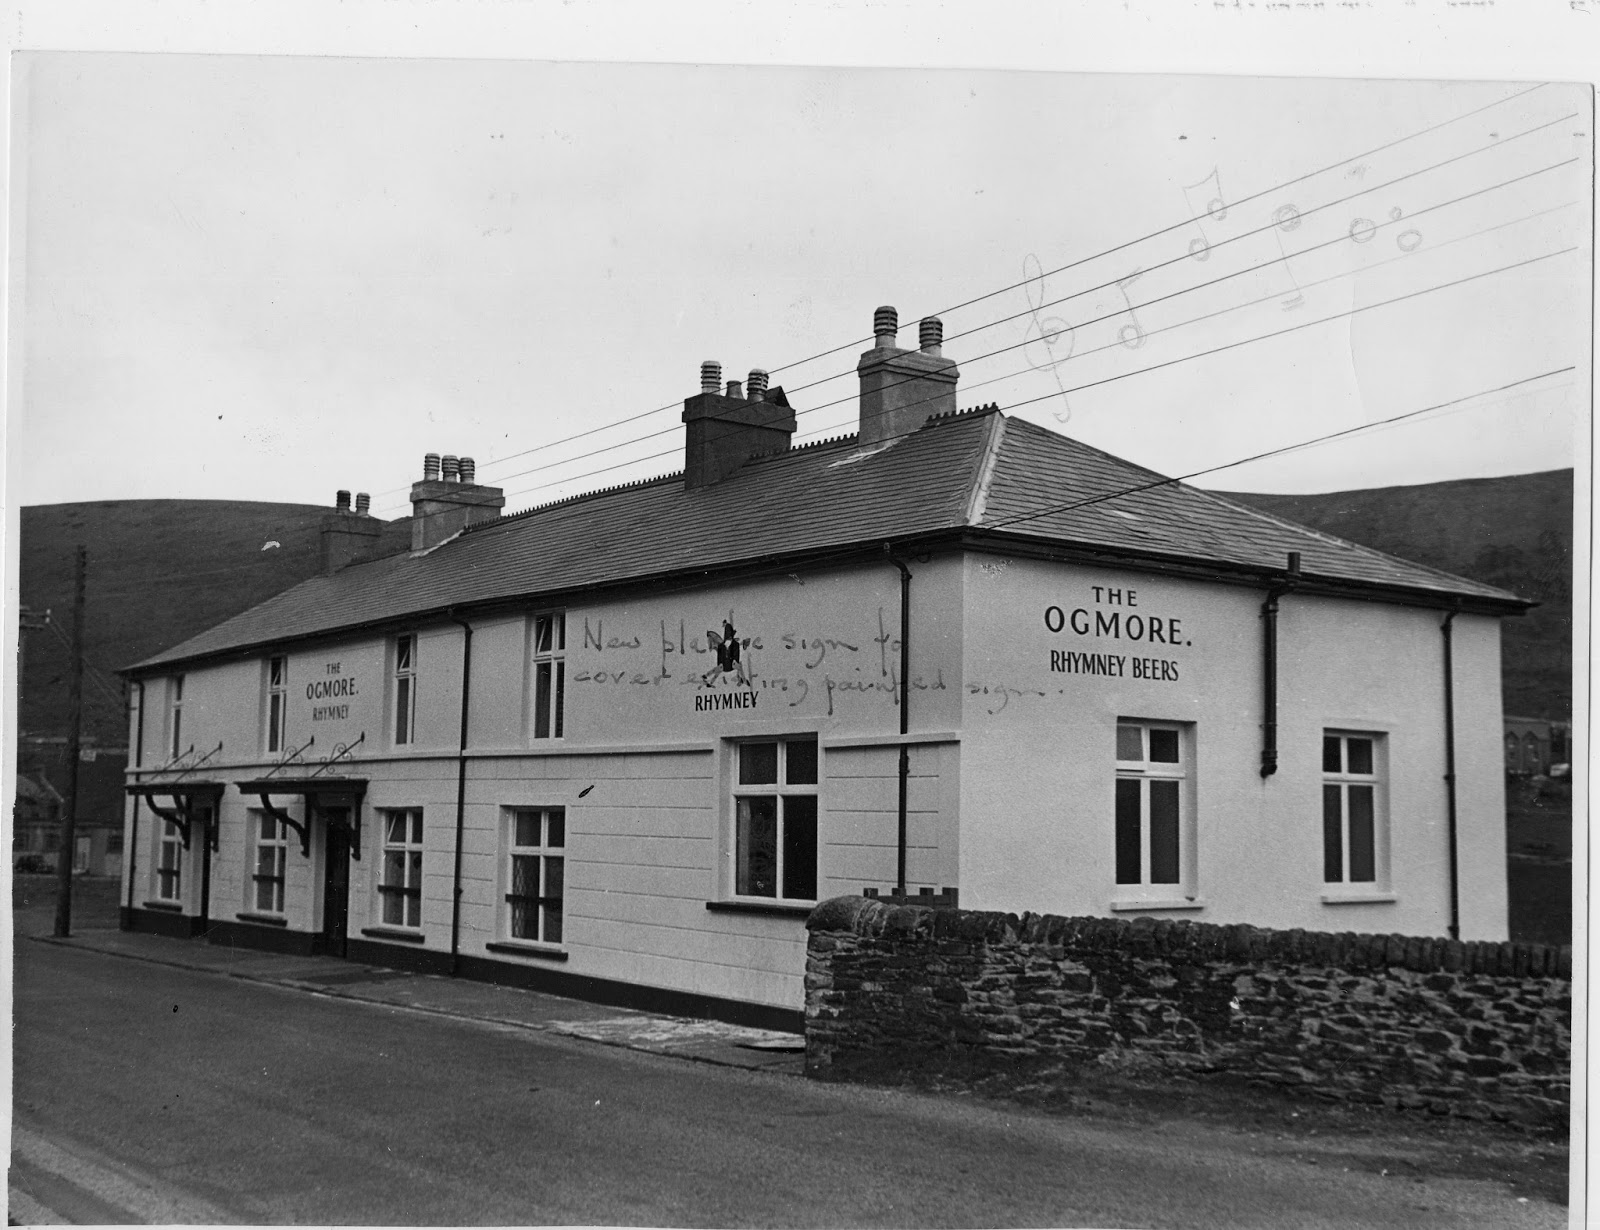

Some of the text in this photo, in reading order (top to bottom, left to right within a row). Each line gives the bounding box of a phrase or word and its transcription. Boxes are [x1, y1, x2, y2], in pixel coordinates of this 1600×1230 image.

[1091, 585, 1138, 607] THE
[1044, 605, 1193, 647] OGMORE.
[583, 616, 641, 651] New
[781, 633, 858, 669] sign
[873, 606, 902, 677] to
[326, 662, 341, 675] THE
[1050, 649, 1179, 681] RHYMNEY BEERS
[306, 677, 359, 700] OGMORE.
[695, 691, 759, 711] RHYMNEY
[312, 704, 350, 721] RHYMNEY
